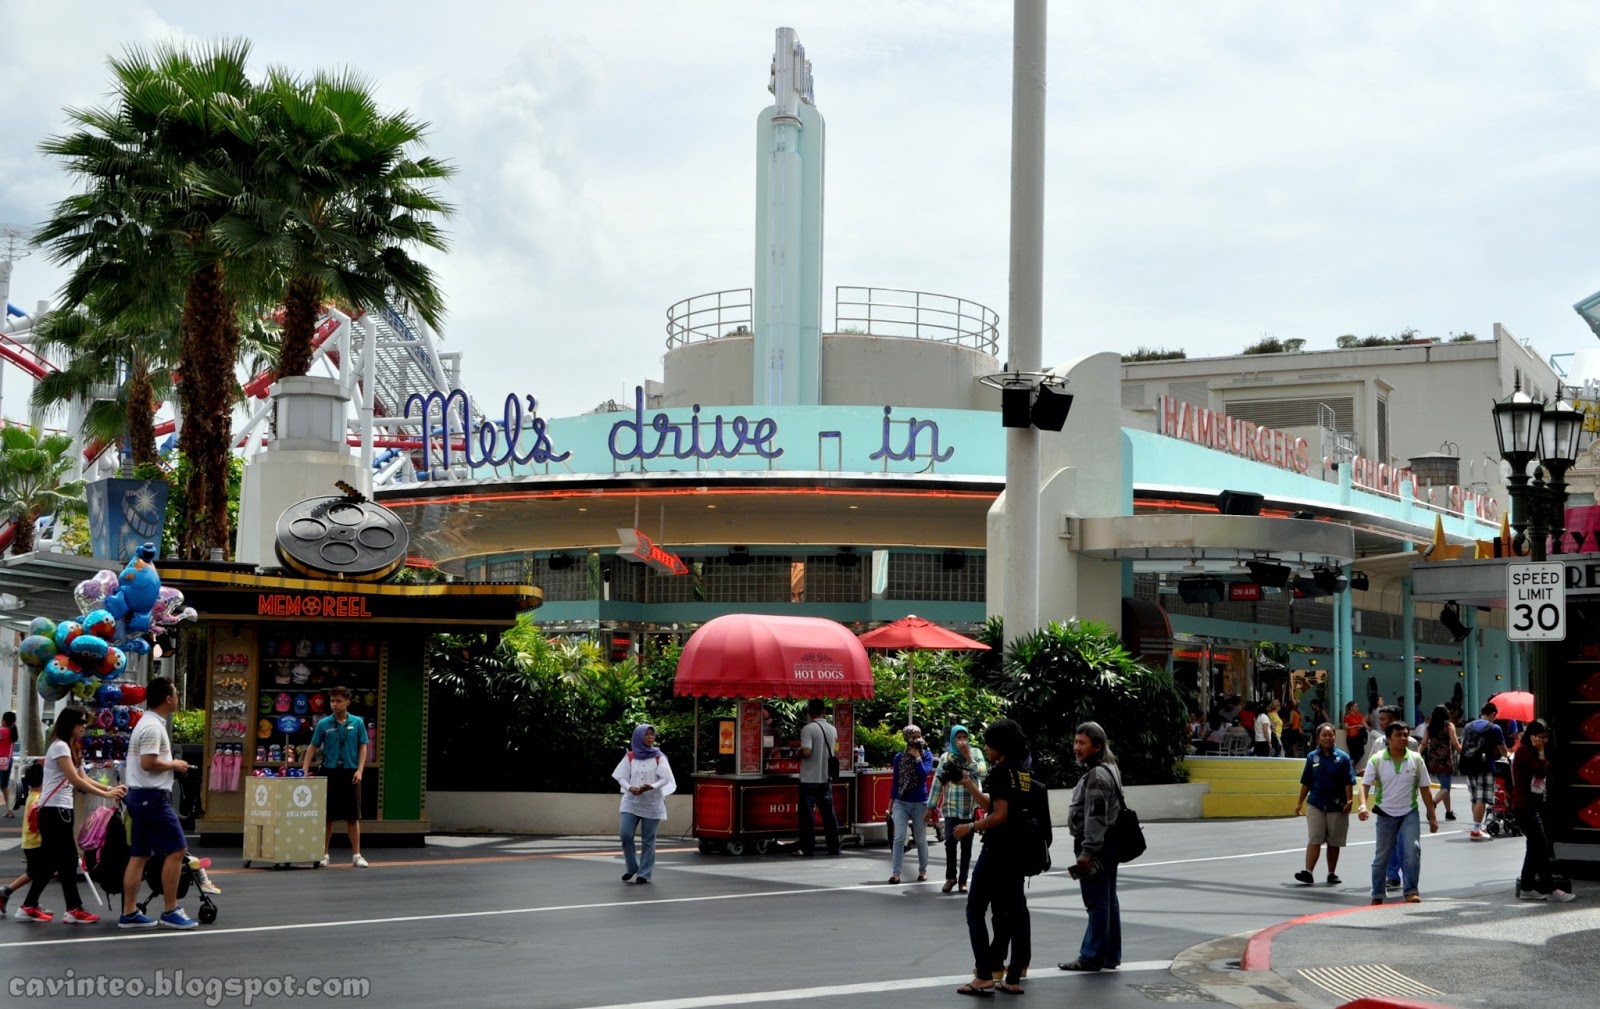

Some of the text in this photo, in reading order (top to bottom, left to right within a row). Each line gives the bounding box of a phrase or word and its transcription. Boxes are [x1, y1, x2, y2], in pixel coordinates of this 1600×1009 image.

[404, 388, 570, 470] Mel's
[608, 386, 784, 462] drive
[869, 405, 955, 462] in
[1162, 395, 1309, 473] HAMBURGERS
[1513, 572, 1560, 585] SPEED
[1518, 588, 1553, 600] LIMIT
[1513, 603, 1560, 631] 30
[794, 669, 845, 679] HOT DOGS
[286, 810, 319, 818] HOLLYWOOD
[769, 803, 791, 813] HOT
